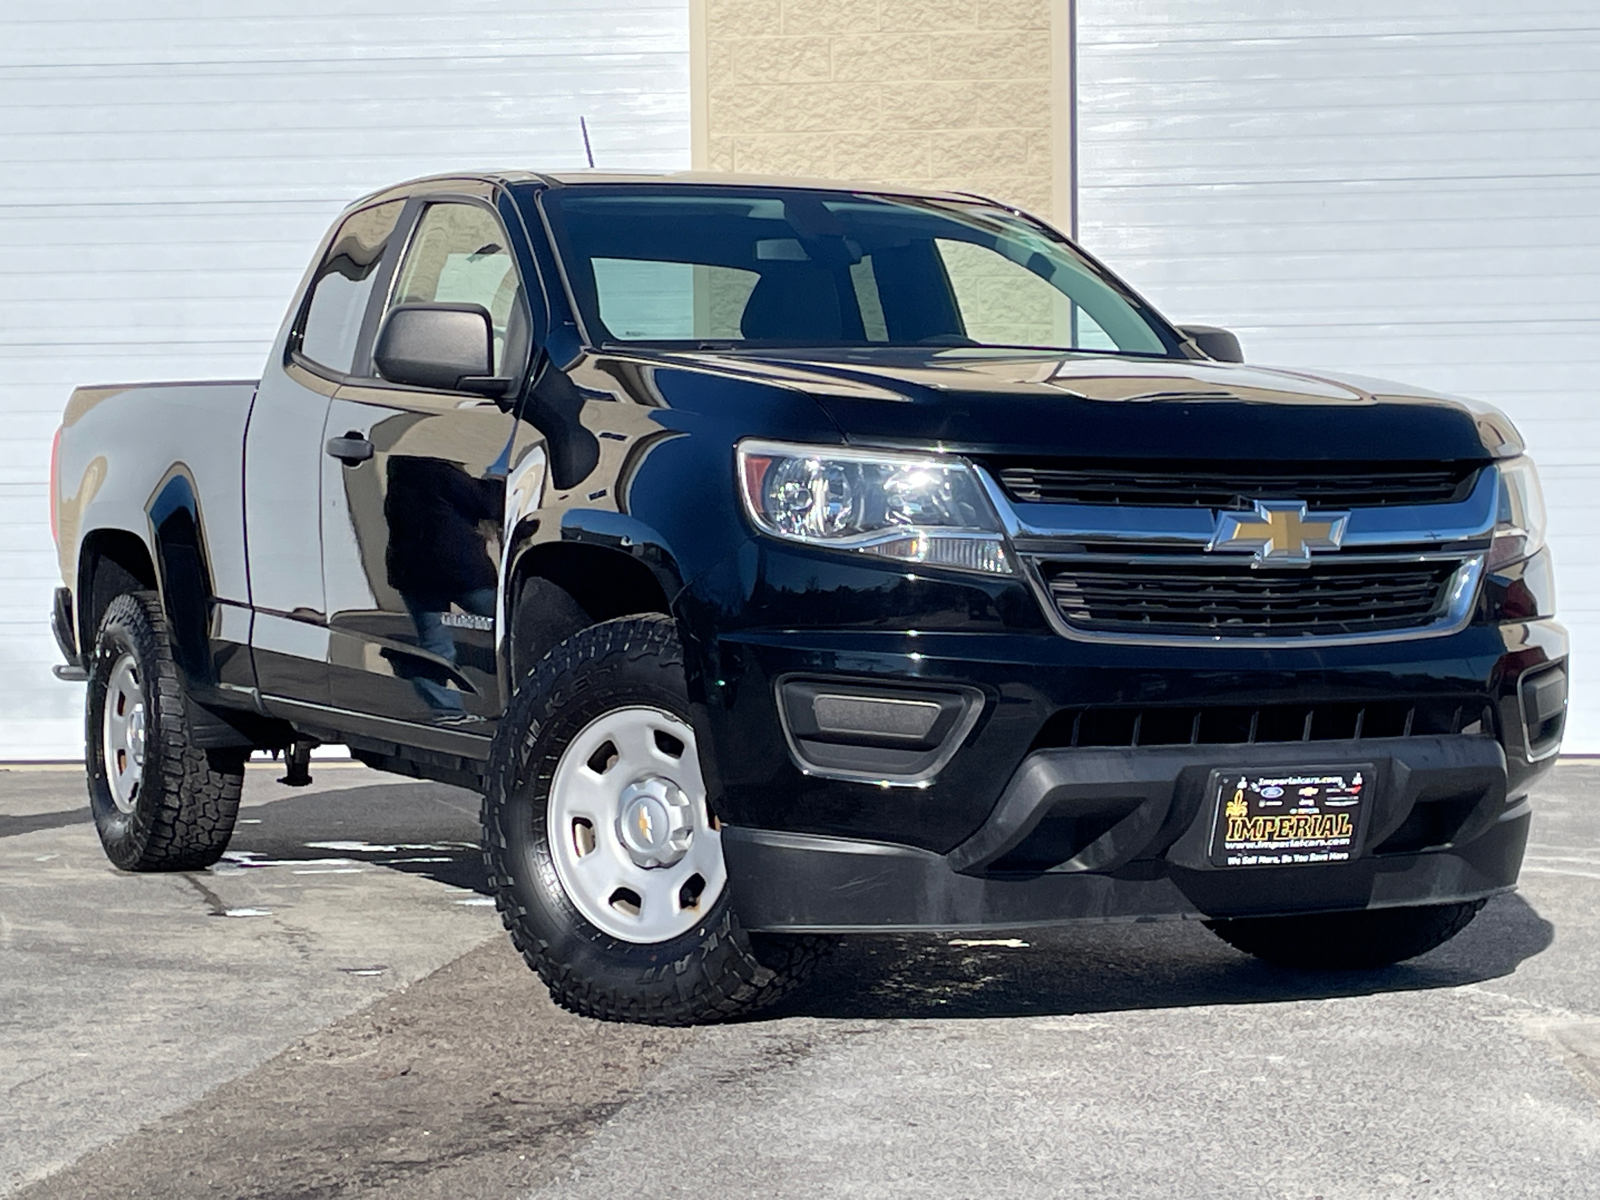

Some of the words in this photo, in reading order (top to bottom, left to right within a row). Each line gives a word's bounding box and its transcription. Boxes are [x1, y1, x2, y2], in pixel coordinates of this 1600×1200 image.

[1225, 813, 1352, 841] IMPERIAL
[1225, 838, 1350, 850] www.imperialcars.com
[1228, 857, 1240, 865] We
[1242, 855, 1257, 864] Sell
[1293, 854, 1309, 862] You
[1309, 853, 1328, 862] Save
[1329, 852, 1349, 860] More
